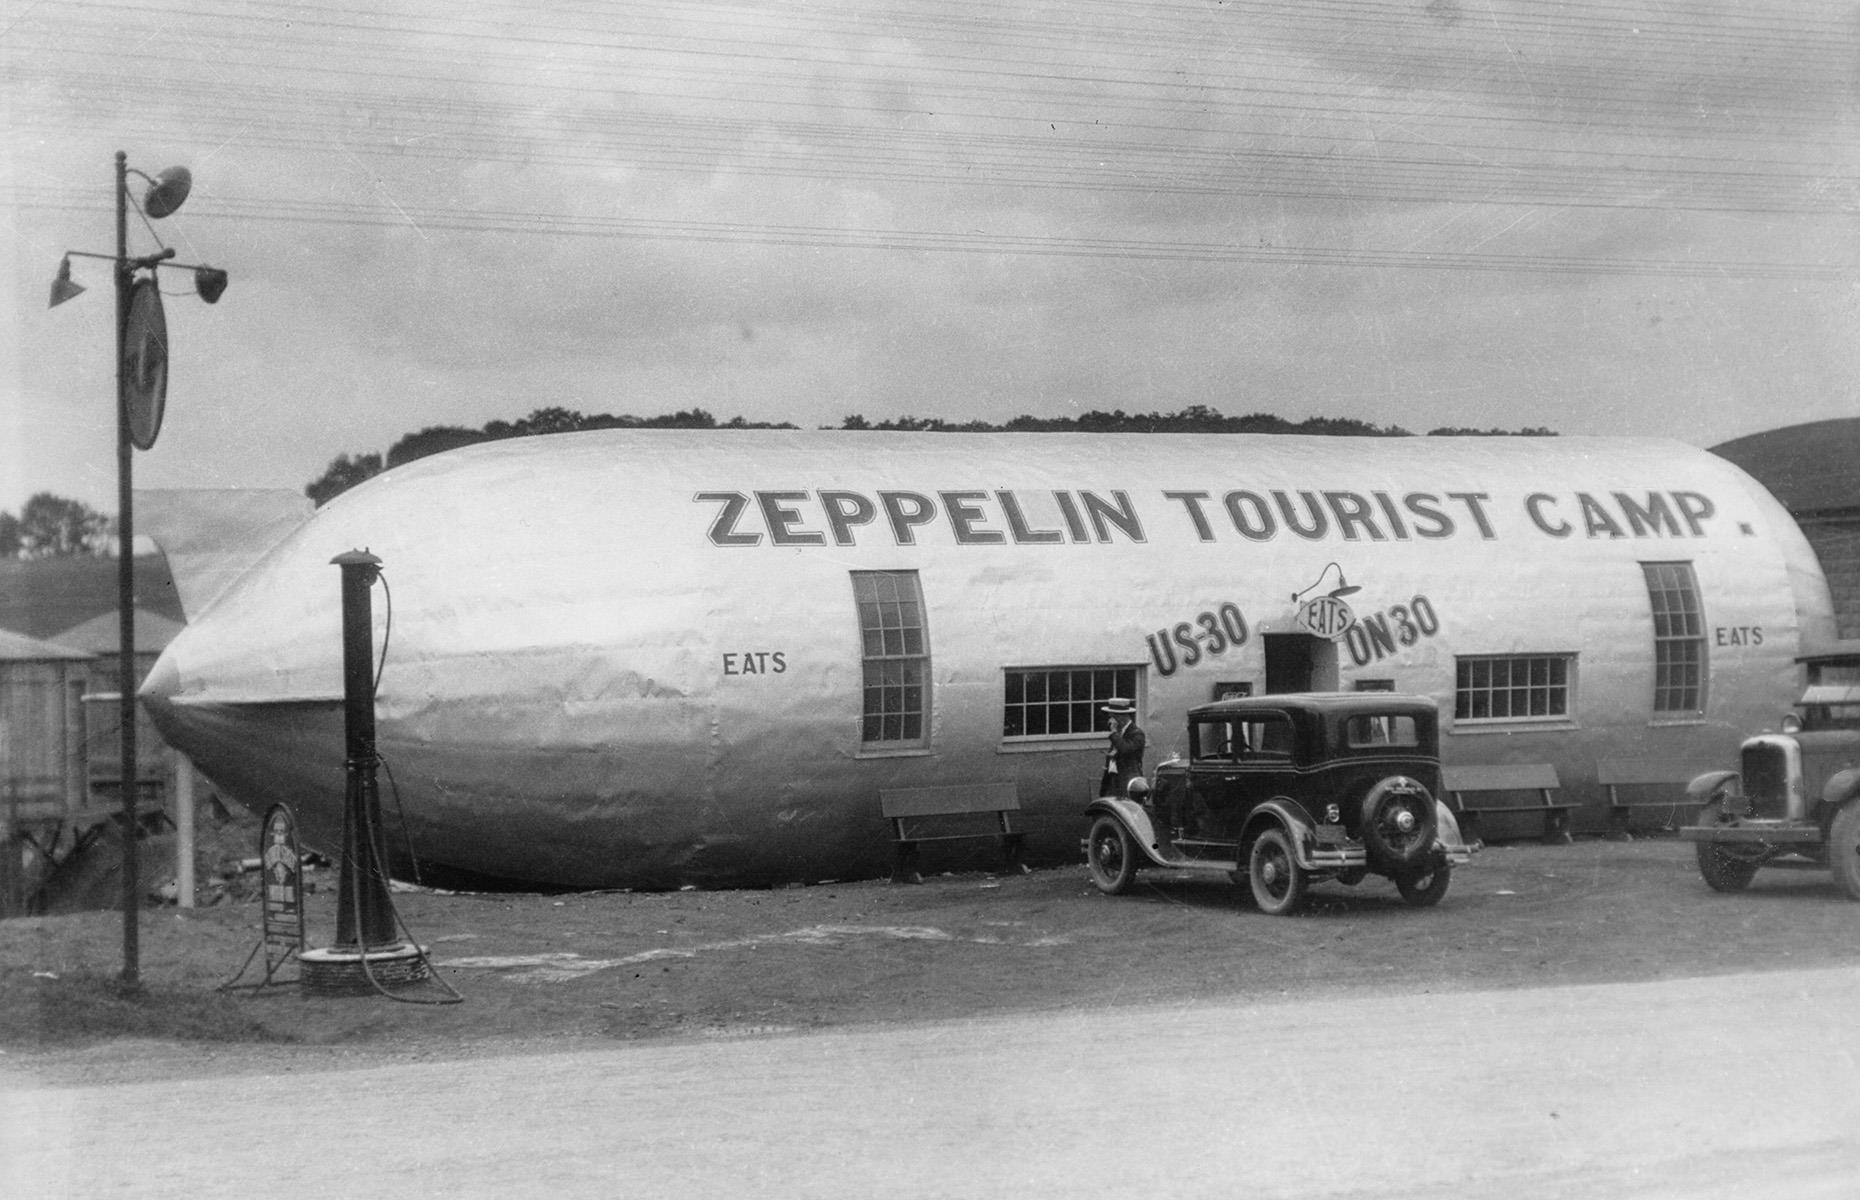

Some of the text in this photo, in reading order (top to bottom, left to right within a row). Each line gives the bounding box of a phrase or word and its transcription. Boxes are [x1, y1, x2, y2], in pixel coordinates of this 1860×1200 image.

[693, 490, 1147, 546] ZEPPELIN
[1162, 490, 1498, 542] TOURIST
[1147, 602, 1249, 677] US-30
[1307, 600, 1350, 636] EATS
[1346, 595, 1438, 666] ON 30
[1716, 626, 1764, 647] EATS
[722, 651, 787, 675] EATS
